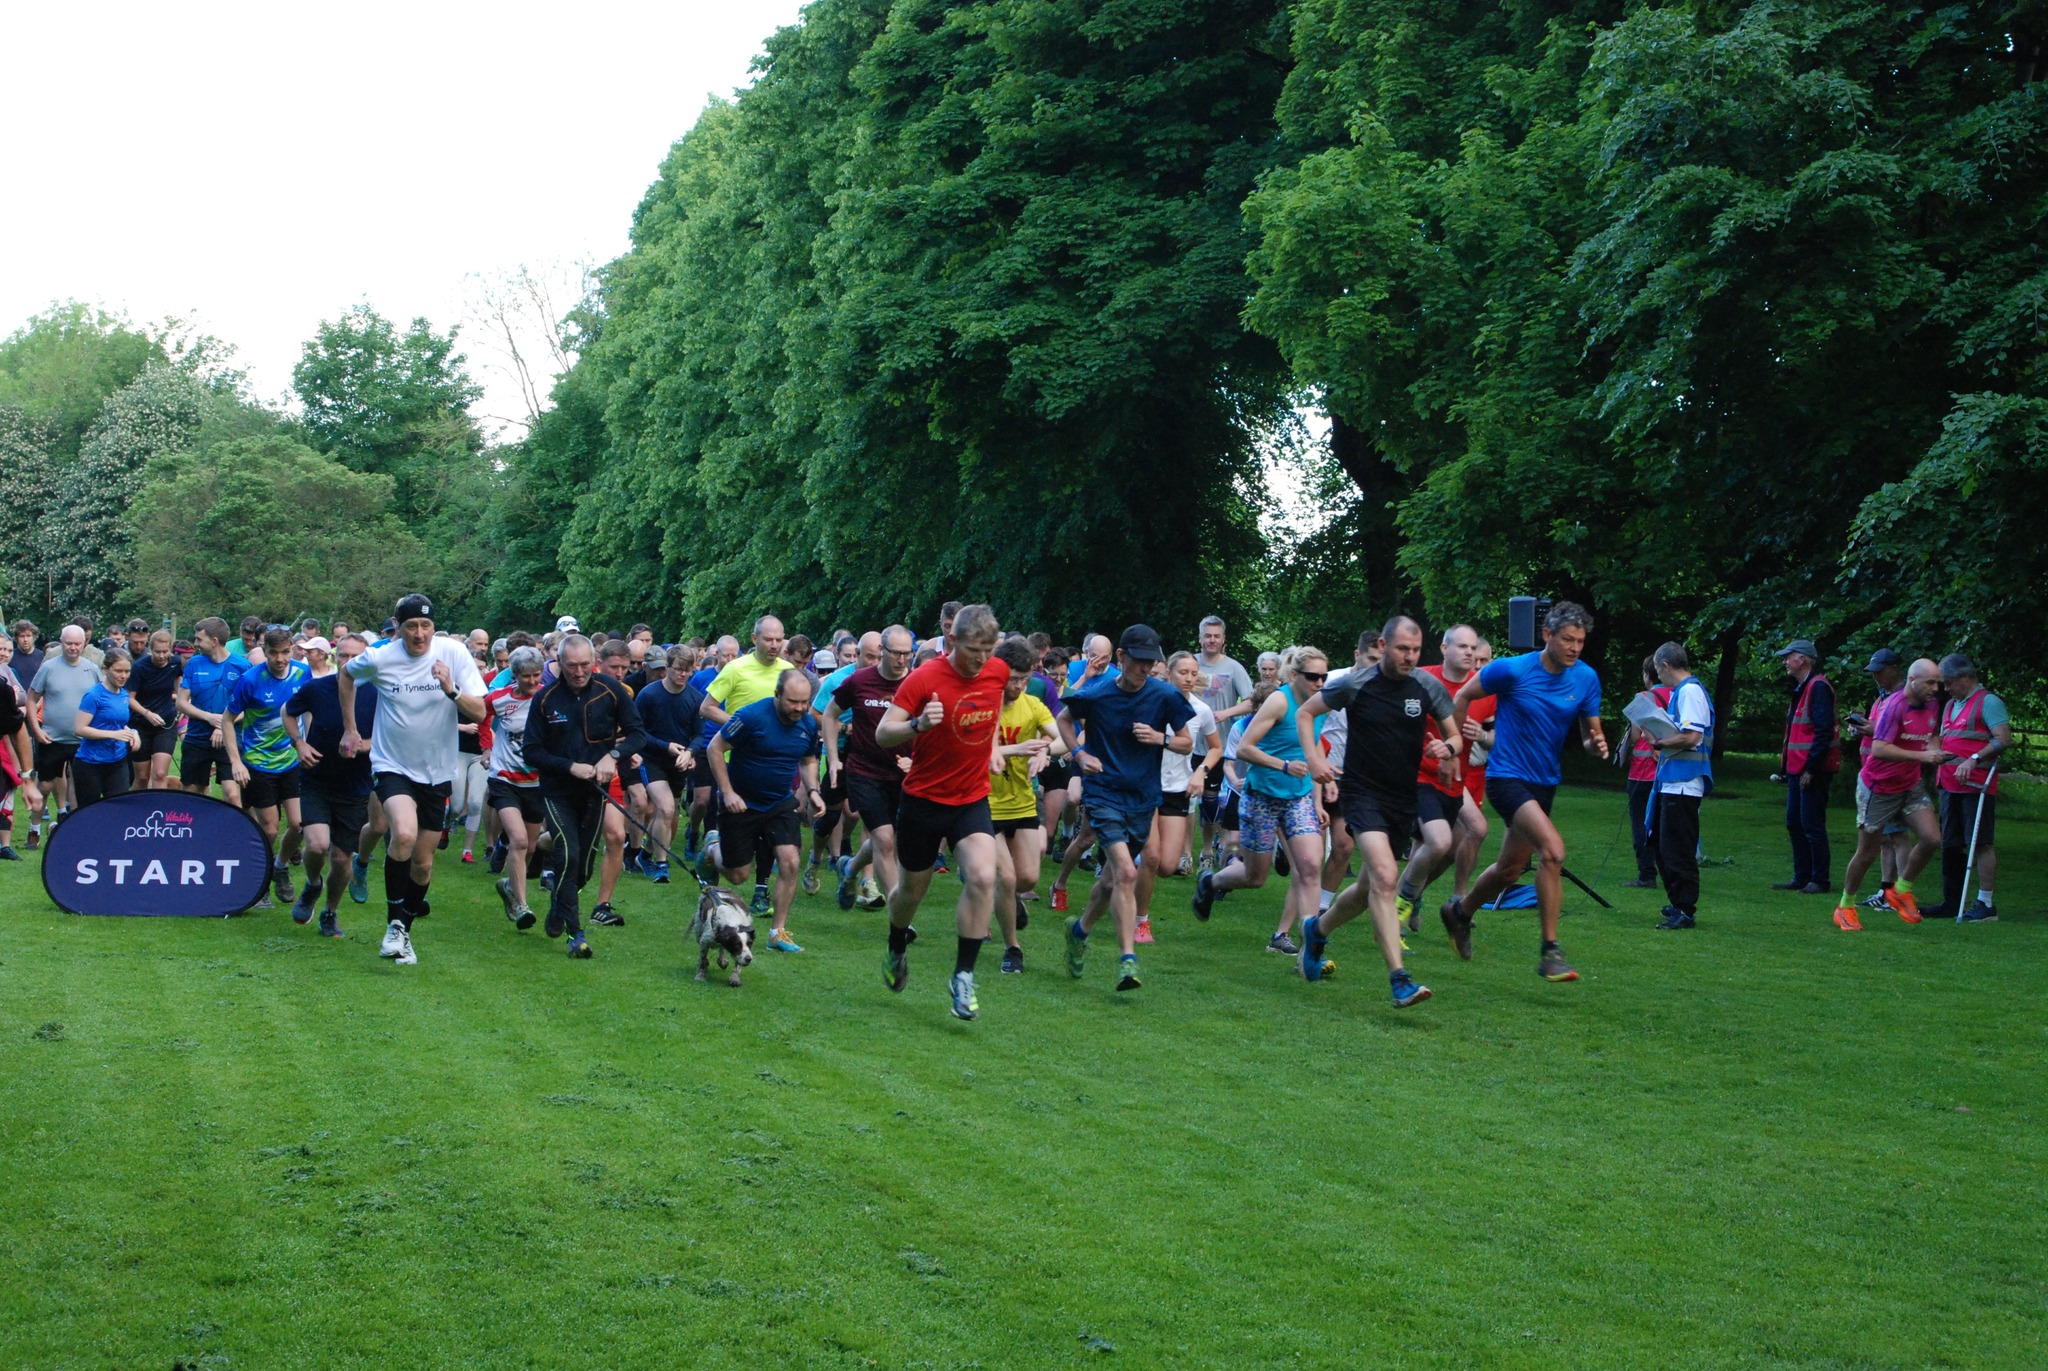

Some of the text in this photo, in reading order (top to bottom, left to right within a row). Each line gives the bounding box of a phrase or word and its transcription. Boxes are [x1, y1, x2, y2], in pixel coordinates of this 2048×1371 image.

[404, 683, 442, 693] Tynedale
[165, 811, 193, 825] Vitality
[124, 818, 192, 841] parkrun
[75, 858, 240, 885] START
